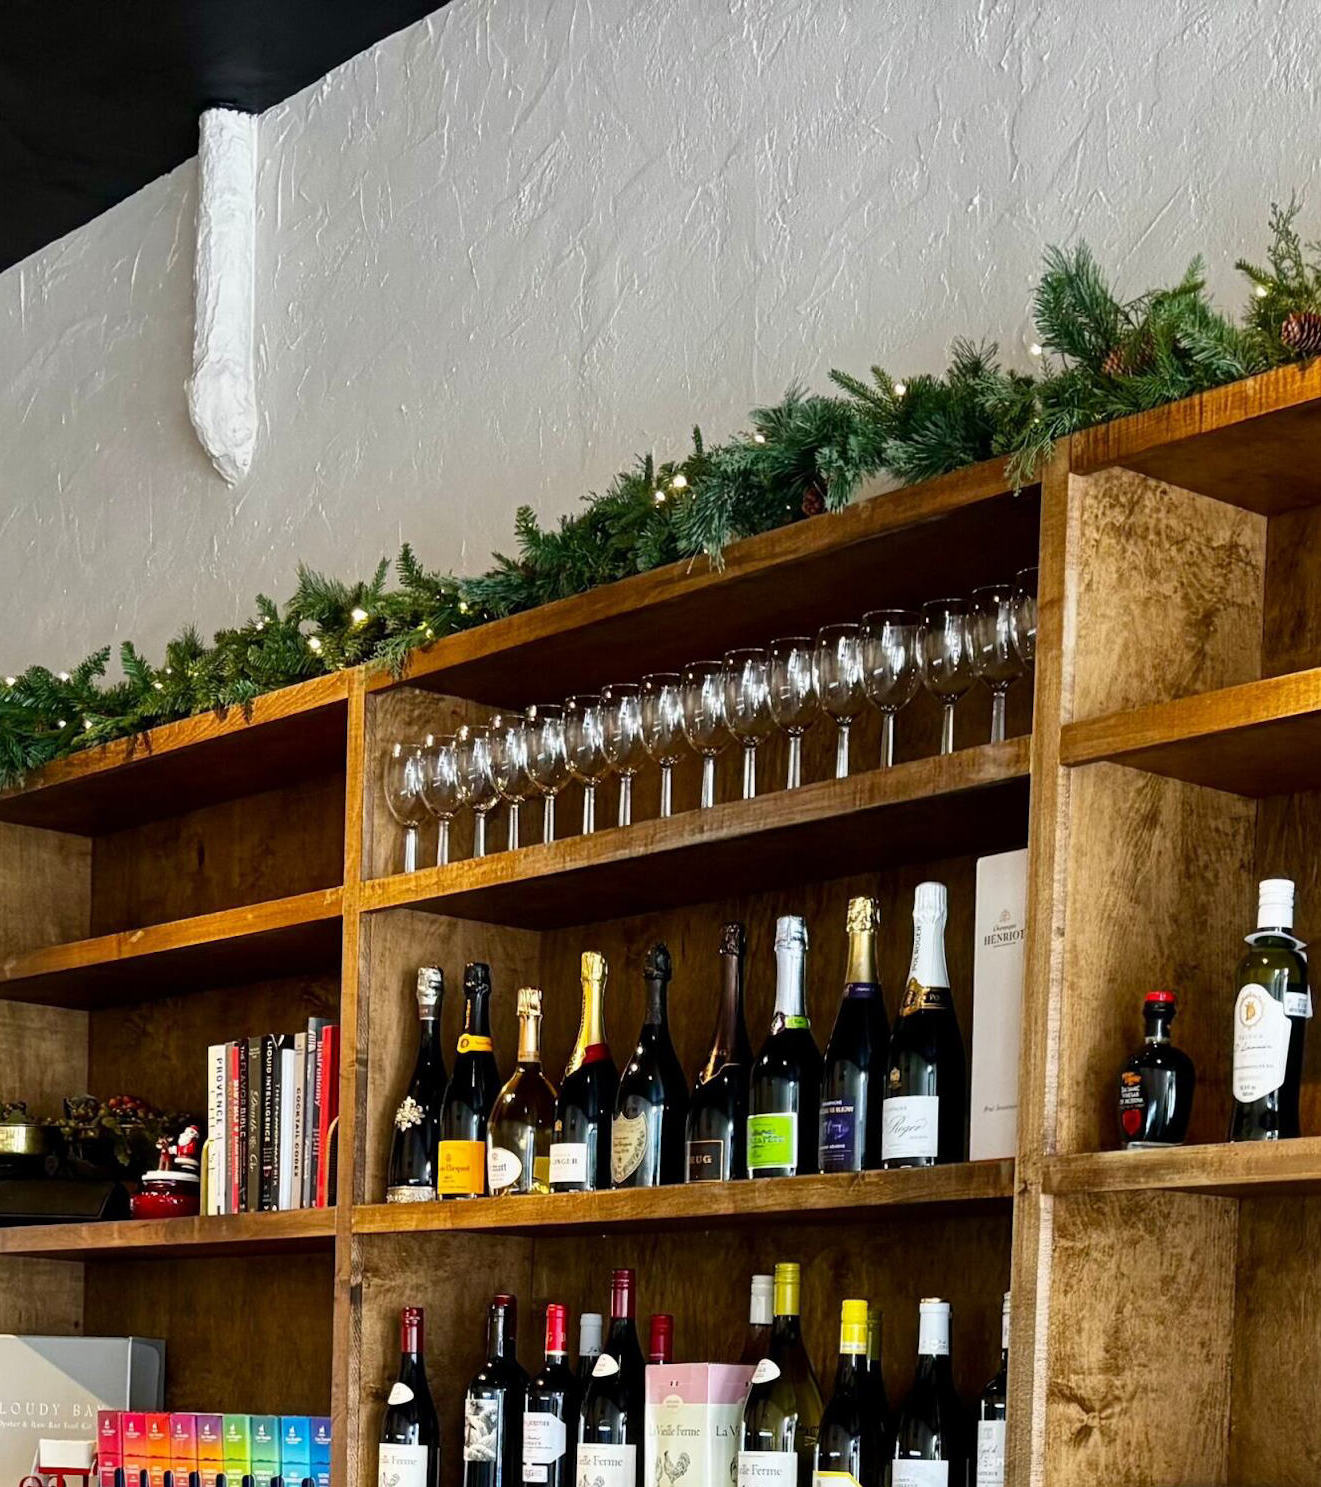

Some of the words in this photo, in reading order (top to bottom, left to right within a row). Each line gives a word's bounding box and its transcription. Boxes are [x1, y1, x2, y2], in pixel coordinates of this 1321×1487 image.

[984, 929, 1025, 946] HENRIOT
[264, 1076, 272, 1142] INTELLIGENCE
[677, 1424, 701, 1437] Ferme
[715, 1425, 728, 1437] La
[593, 1455, 623, 1468] Ferme
[751, 1463, 783, 1476] Ferme
